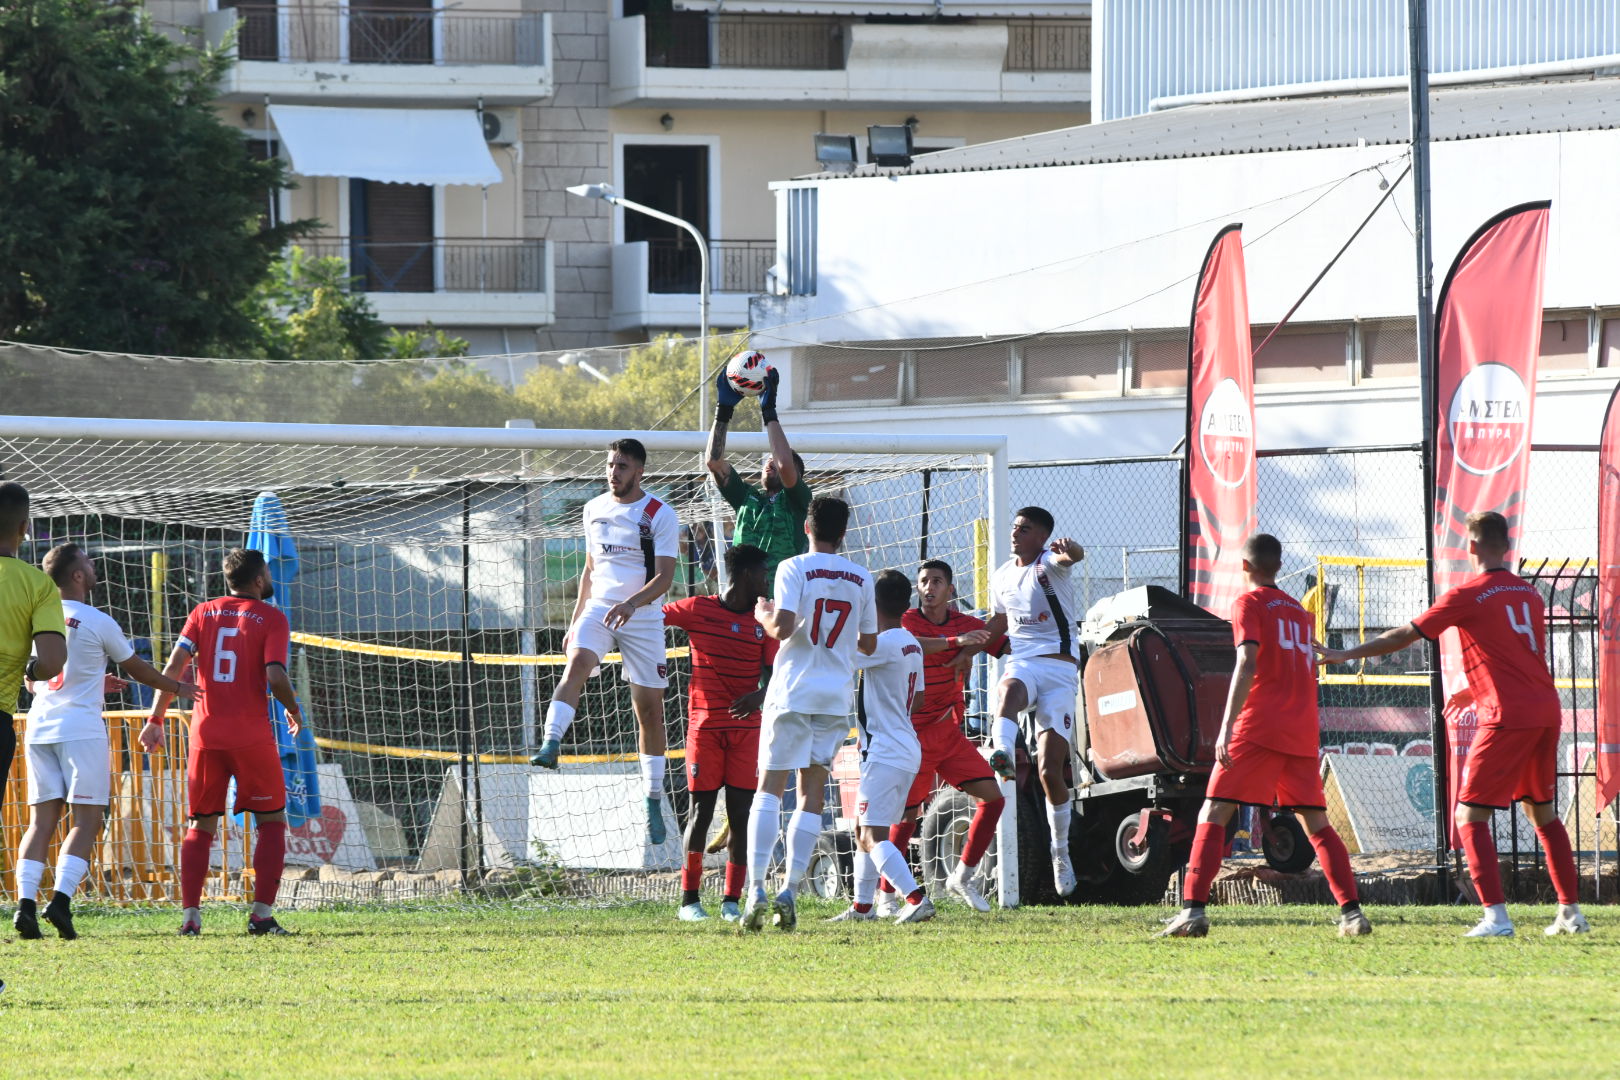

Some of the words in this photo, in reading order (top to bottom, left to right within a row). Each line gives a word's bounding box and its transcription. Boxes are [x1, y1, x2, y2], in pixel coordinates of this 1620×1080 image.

[1207, 413, 1248, 432] ΑΣΤΕΛ
[1464, 427, 1511, 439] ΜΠΥΡΑ
[810, 597, 852, 649] 17
[1504, 601, 1540, 655] 4
[213, 626, 238, 683] 6
